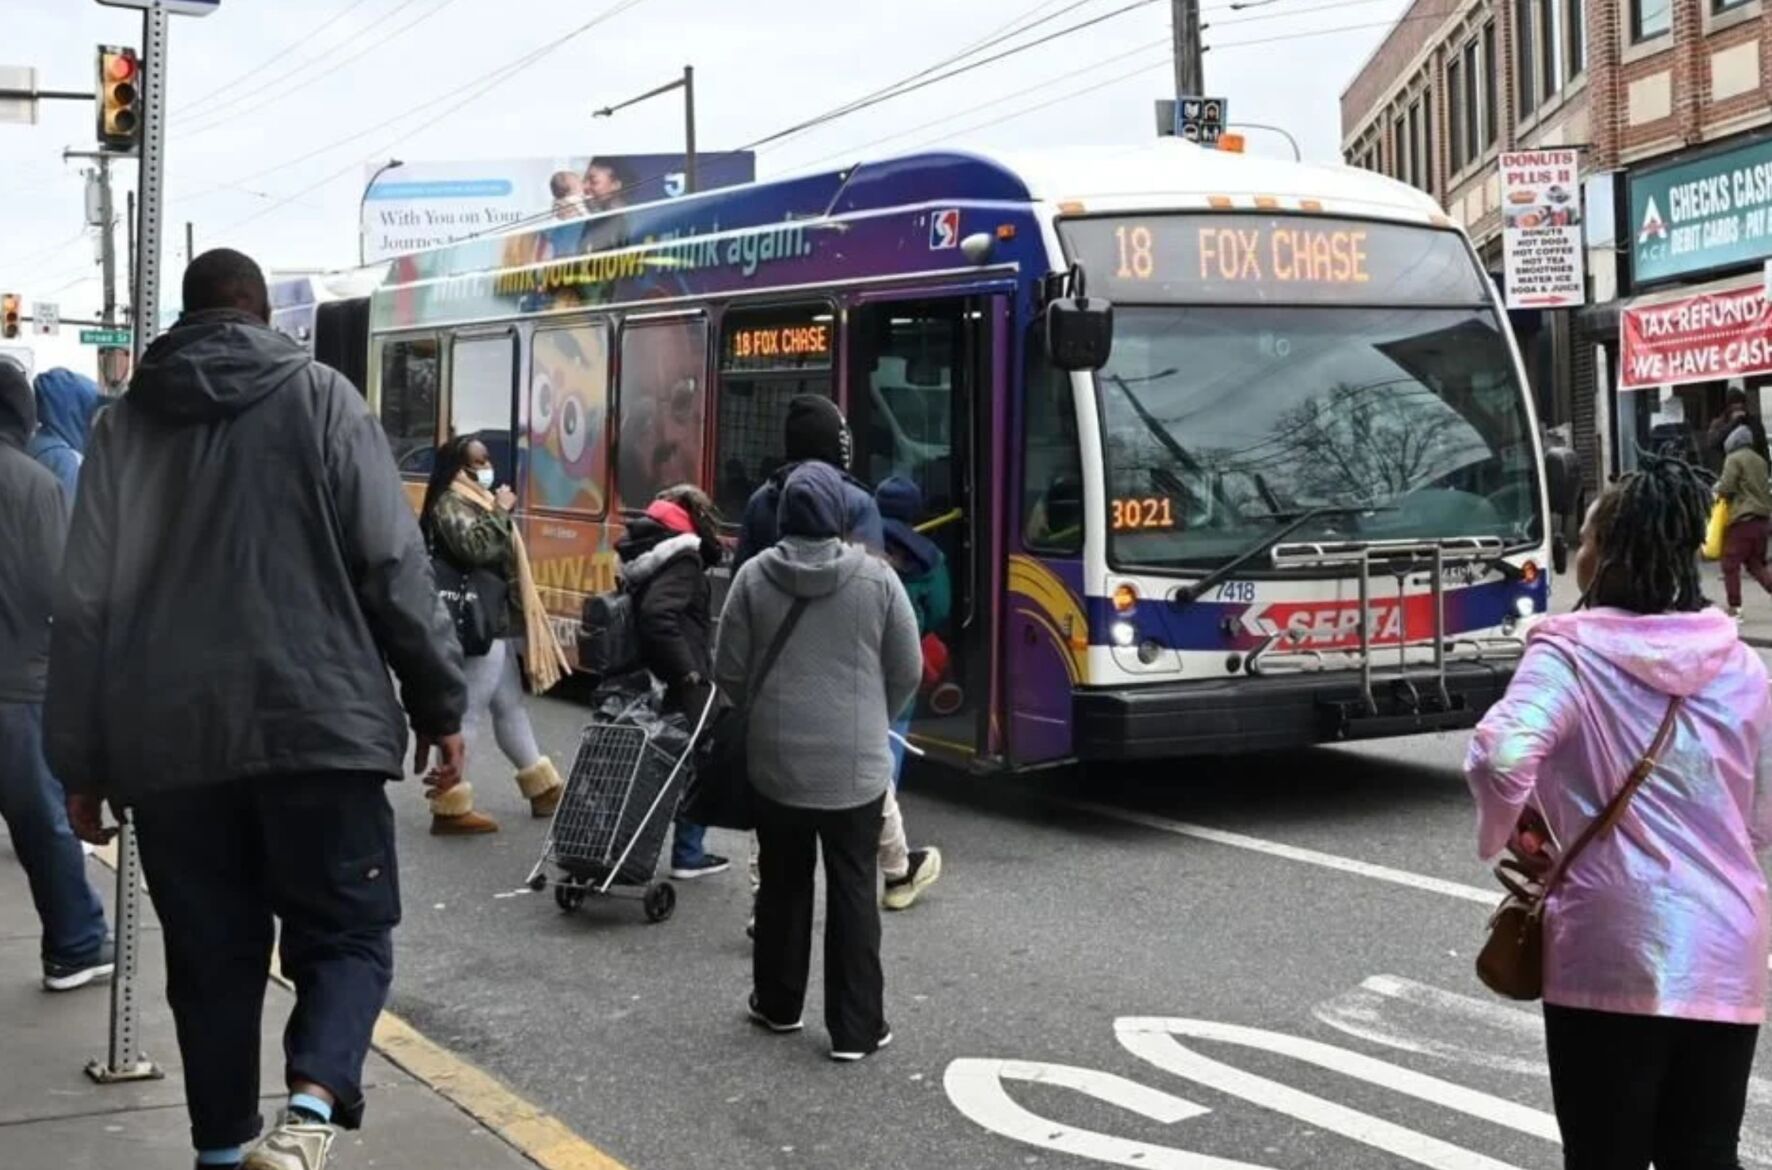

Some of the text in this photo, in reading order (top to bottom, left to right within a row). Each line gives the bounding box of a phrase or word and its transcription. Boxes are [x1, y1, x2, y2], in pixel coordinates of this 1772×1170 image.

[1503, 152, 1573, 167] DONUTS
[1507, 170, 1570, 185] PLUS II
[1669, 174, 1731, 223] CHECKS
[380, 207, 522, 226] With You on Your
[1522, 228, 1563, 237] DONUTS
[1670, 224, 1701, 255] DEBIT
[540, 262, 574, 291] you
[656, 220, 720, 272] Think
[727, 211, 811, 276] again.
[1518, 237, 1568, 247] HOT DOGS
[1535, 247, 1573, 255] COFFEE
[1116, 226, 1370, 281] 18 FOX CHASE
[1546, 256, 1565, 264] TEA
[1641, 244, 1666, 262] ACE
[1515, 265, 1574, 274] SMOOTHIES
[1518, 275, 1552, 283] WATER
[1511, 286, 1537, 294] SODA
[1551, 283, 1580, 292] JUICE
[735, 325, 827, 356] 18 FOX CHASE
[1633, 354, 1663, 379] WE
[1668, 345, 1720, 377] HAVE
[1111, 497, 1174, 529] 3021
[1216, 582, 1255, 601] 7418
[1284, 605, 1401, 644] SEPTA
